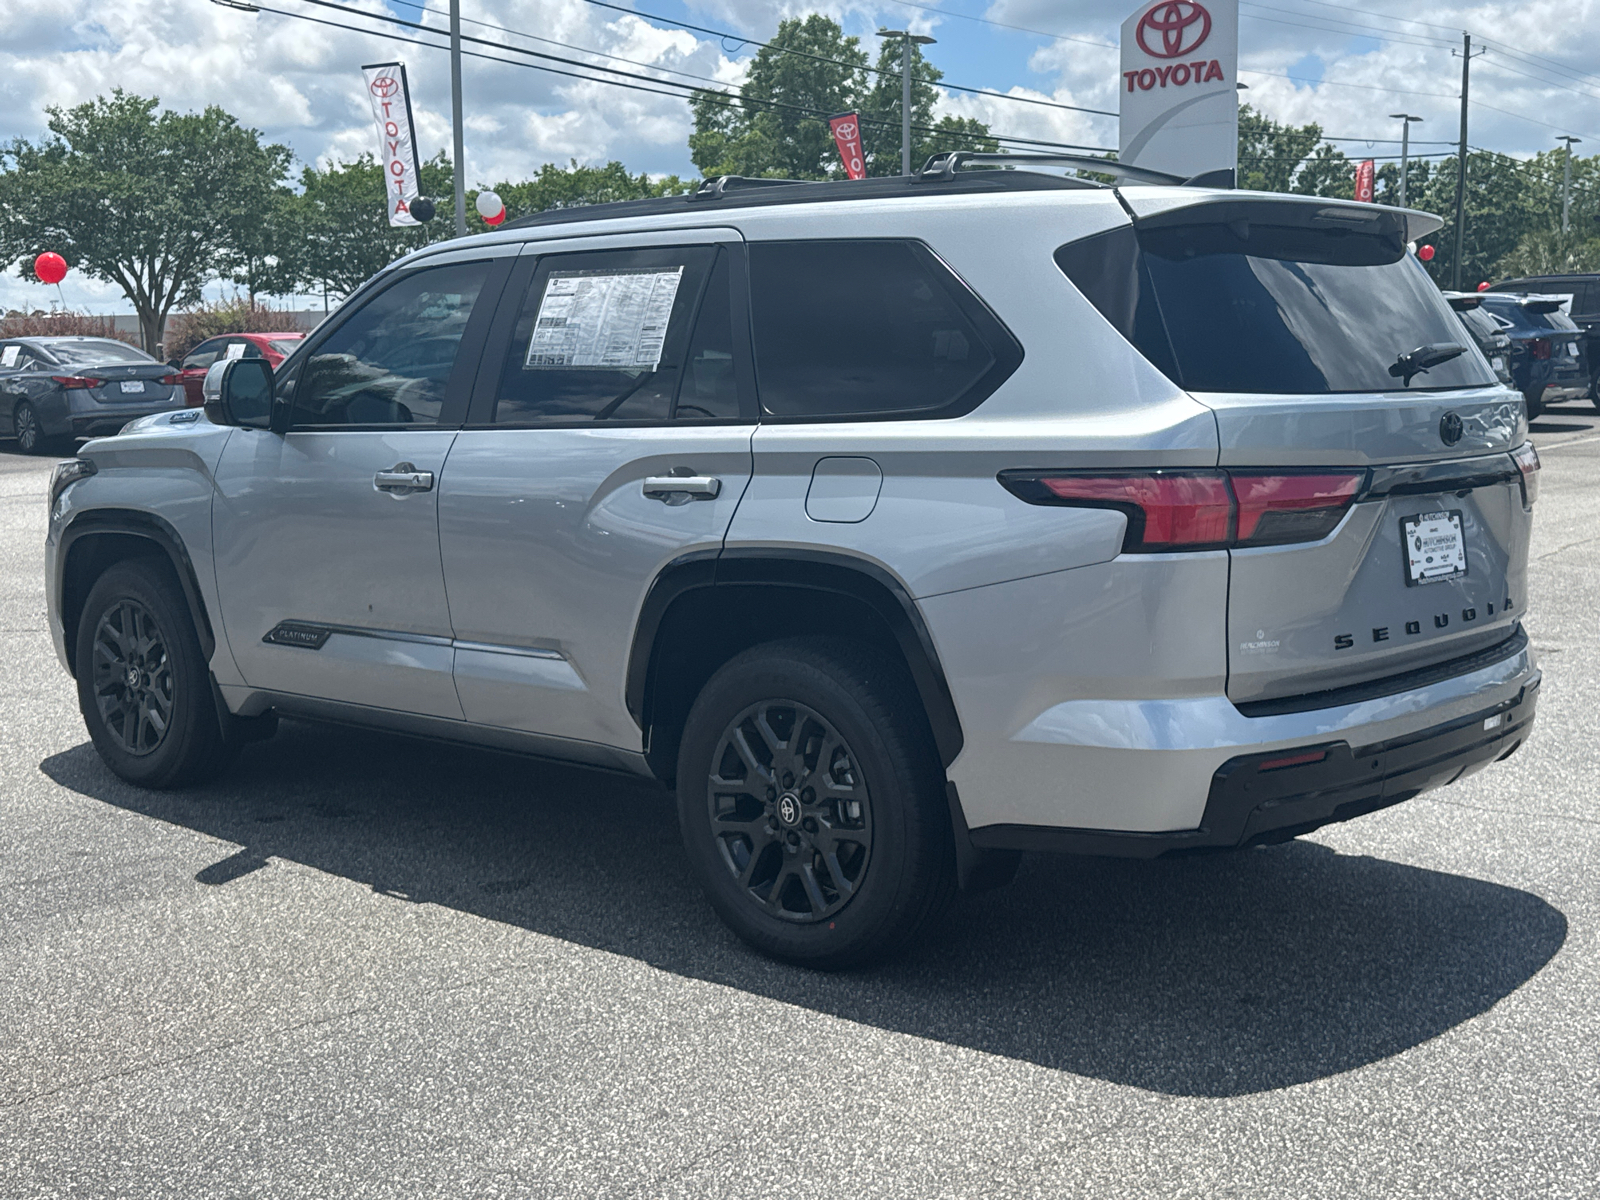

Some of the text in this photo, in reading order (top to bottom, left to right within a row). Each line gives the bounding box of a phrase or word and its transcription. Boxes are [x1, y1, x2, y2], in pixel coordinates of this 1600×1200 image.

[1123, 59, 1224, 93] TOYOTA
[381, 102, 409, 214] TOYOTA
[280, 629, 318, 641] PLATINUM
[1334, 598, 1514, 650] SEQUOIA
